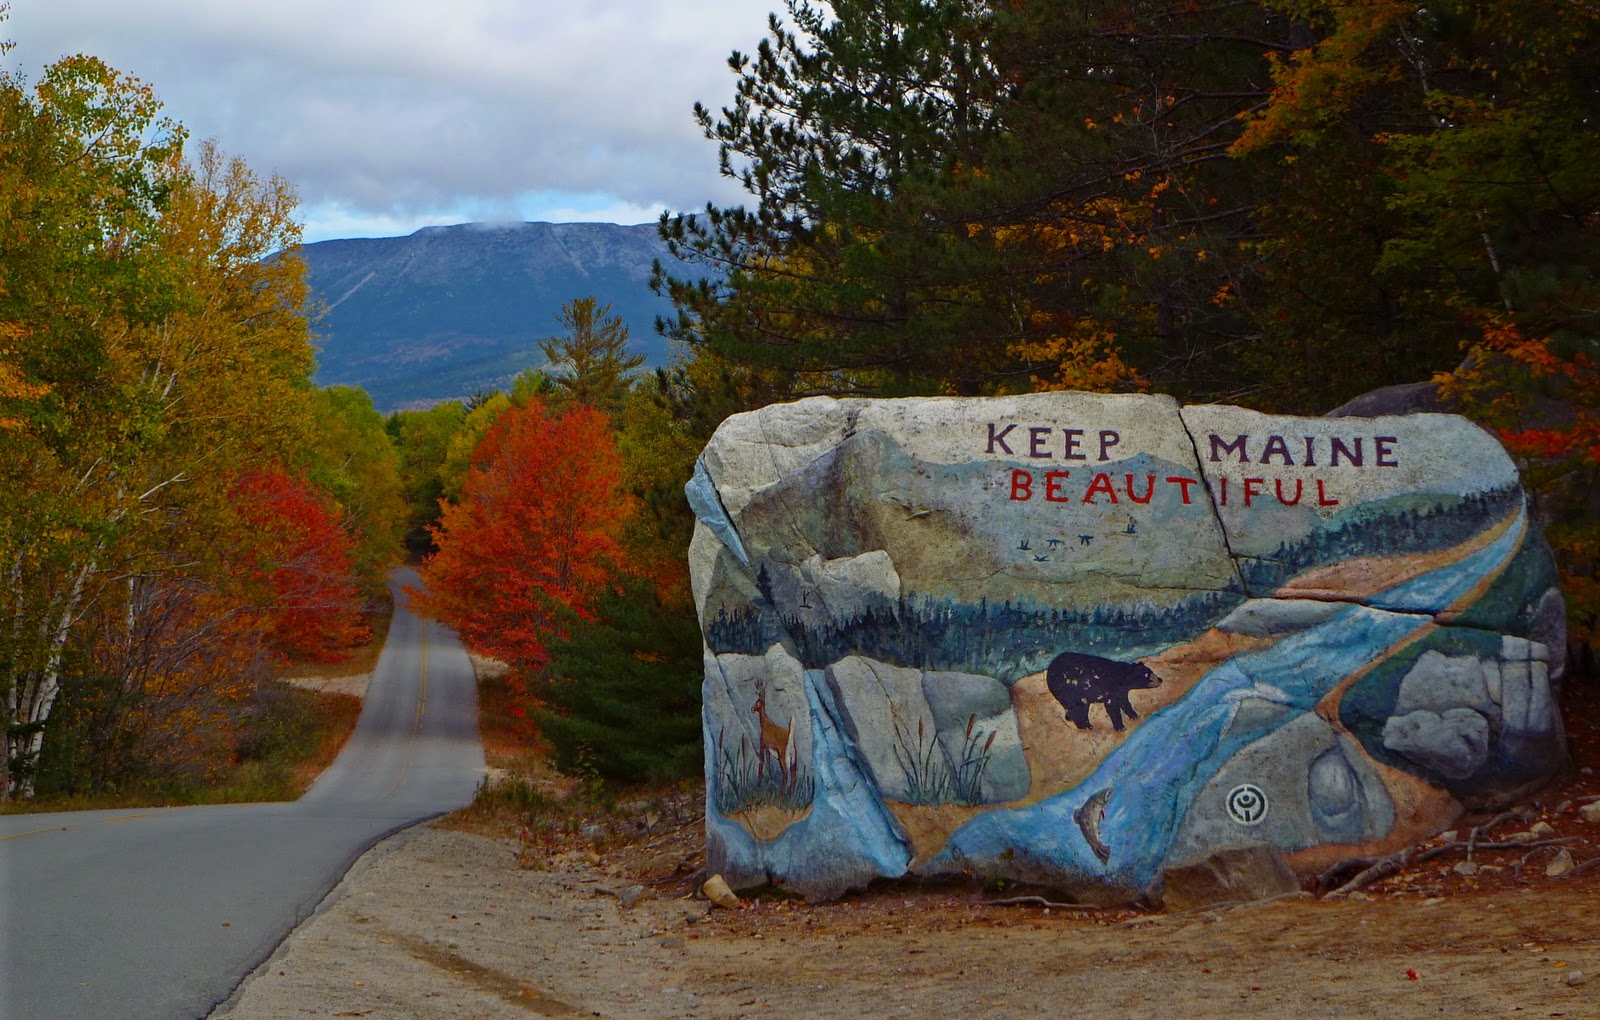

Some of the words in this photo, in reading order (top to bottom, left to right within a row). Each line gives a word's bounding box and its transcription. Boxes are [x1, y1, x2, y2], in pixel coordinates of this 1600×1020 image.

[985, 423, 1121, 461] KEEP
[1209, 434, 1399, 468] MAINE
[1010, 469, 1339, 507] BEAUTIFUL
